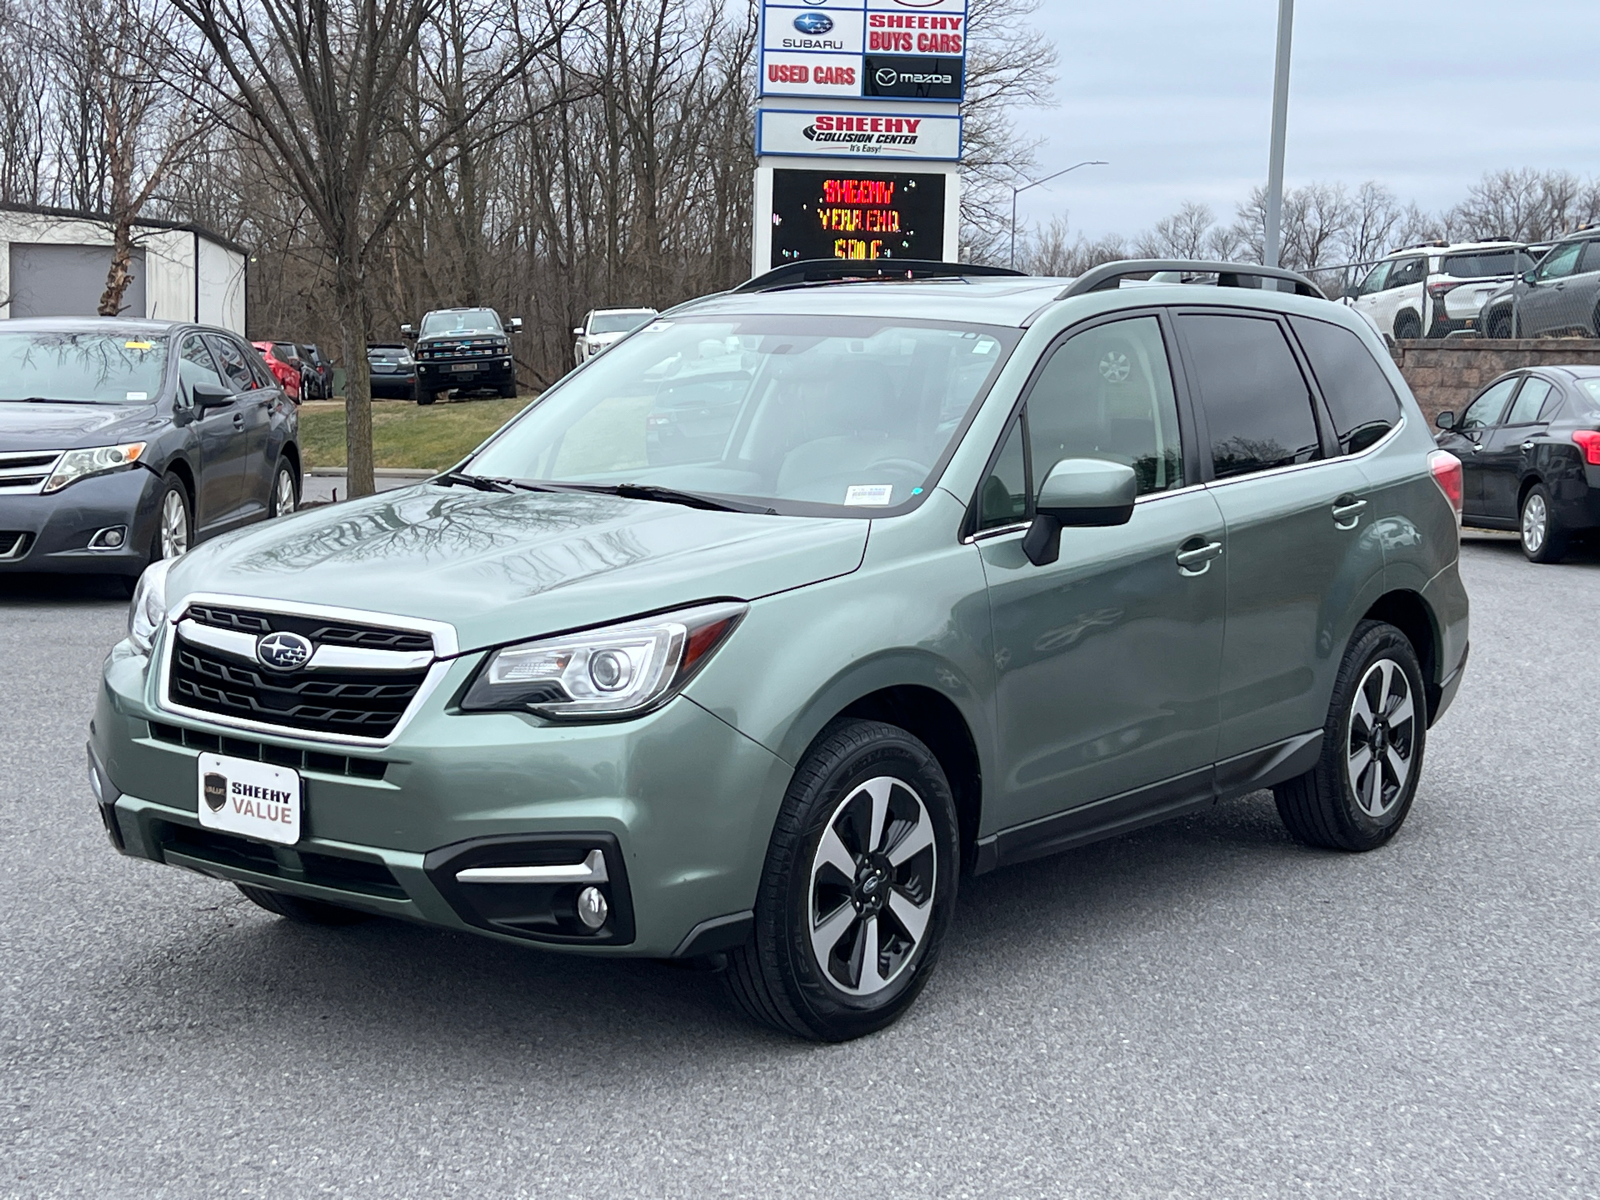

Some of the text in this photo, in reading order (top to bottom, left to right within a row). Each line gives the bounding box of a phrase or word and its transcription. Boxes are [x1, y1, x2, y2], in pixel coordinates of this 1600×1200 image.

[869, 15, 963, 30] SHEEHY
[782, 38, 843, 50] SUBARU
[869, 31, 963, 54] BUYS CARS
[768, 64, 856, 86] USED CARS
[815, 116, 921, 133] SHEEHY
[815, 132, 918, 145] COLLISION CENTER
[849, 144, 882, 154] It's Easy!
[205, 785, 225, 796] VALUE
[231, 782, 291, 804] SHEEHY
[232, 797, 292, 824] VALUE
